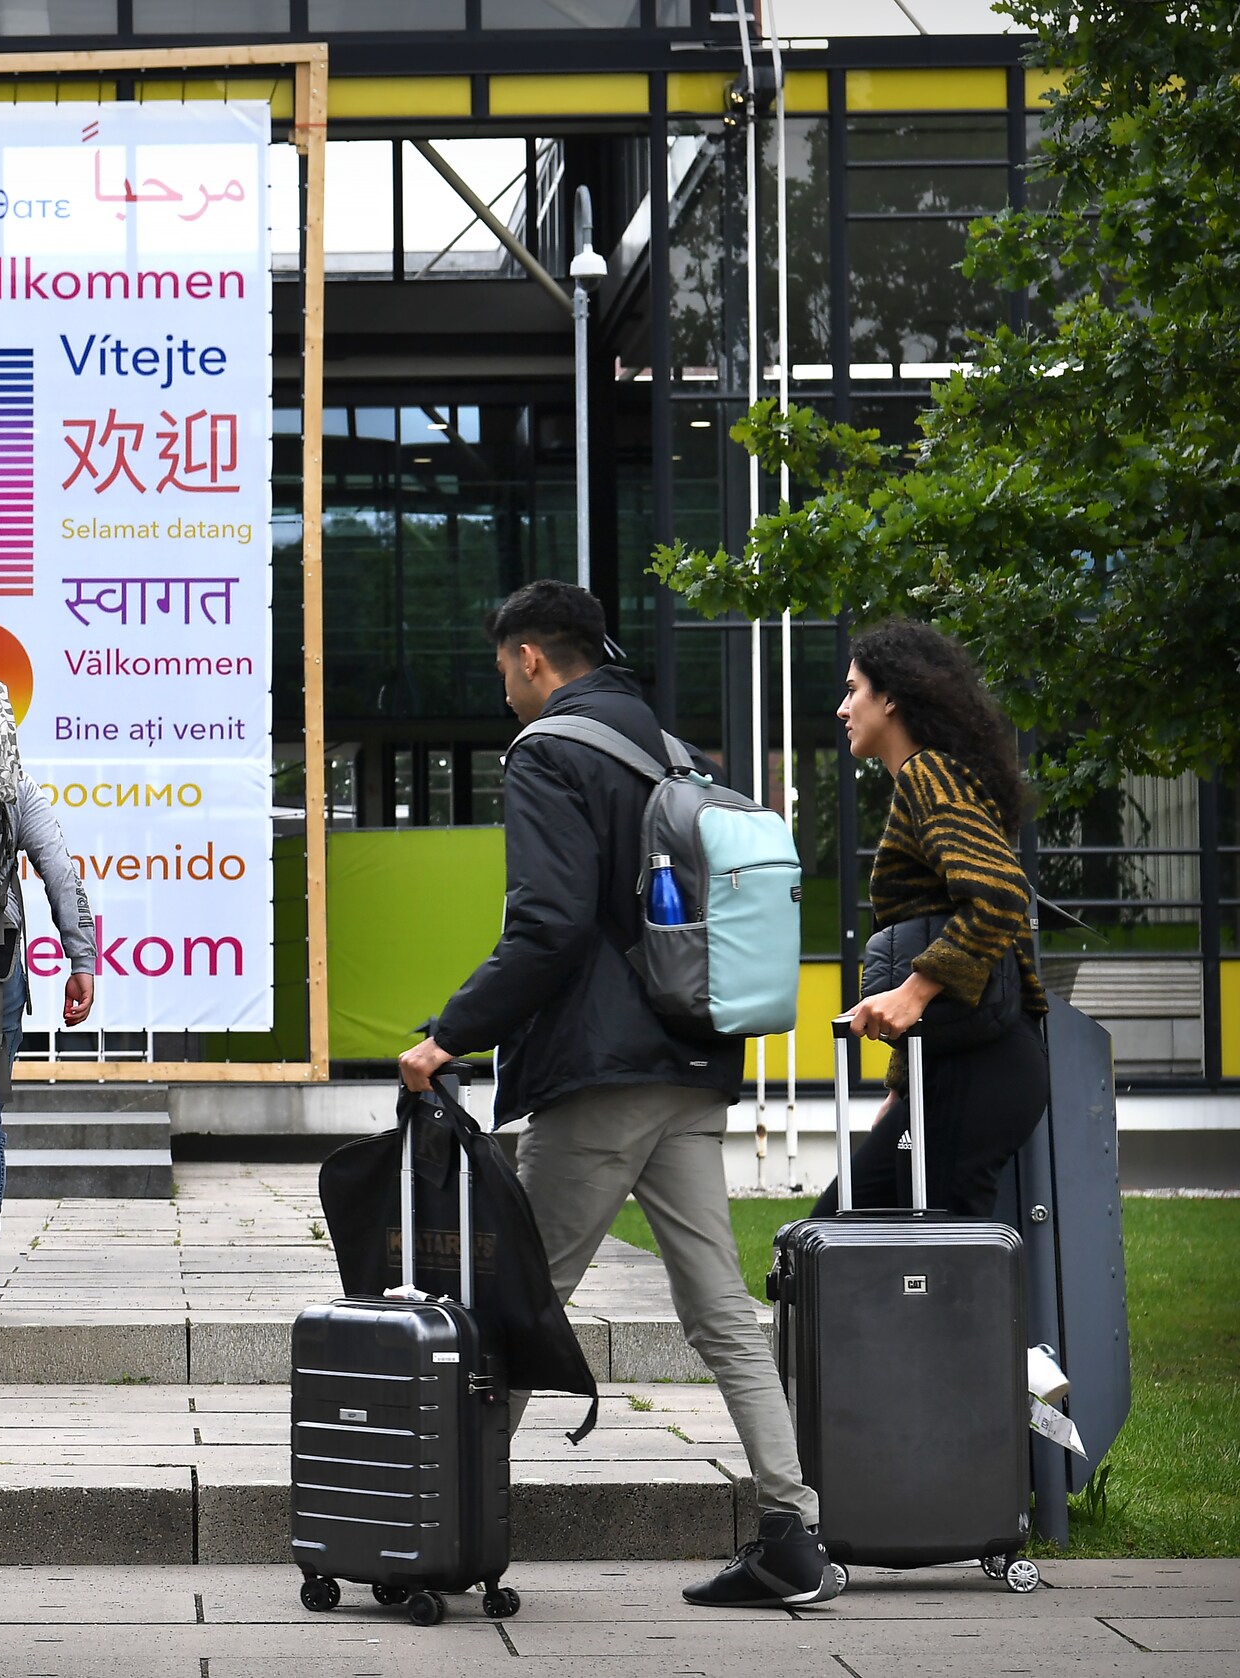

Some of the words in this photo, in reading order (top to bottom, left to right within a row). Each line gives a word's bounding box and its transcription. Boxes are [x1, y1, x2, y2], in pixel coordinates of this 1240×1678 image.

[60, 334, 228, 390] Vítejte
[62, 408, 241, 494] 欢迎
[62, 517, 160, 540] Selamat
[166, 517, 253, 545] datang
[62, 577, 240, 627] स्वागत
[64, 647, 254, 676] Välkommen
[54, 716, 120, 741] Bine
[172, 716, 246, 741] venit
